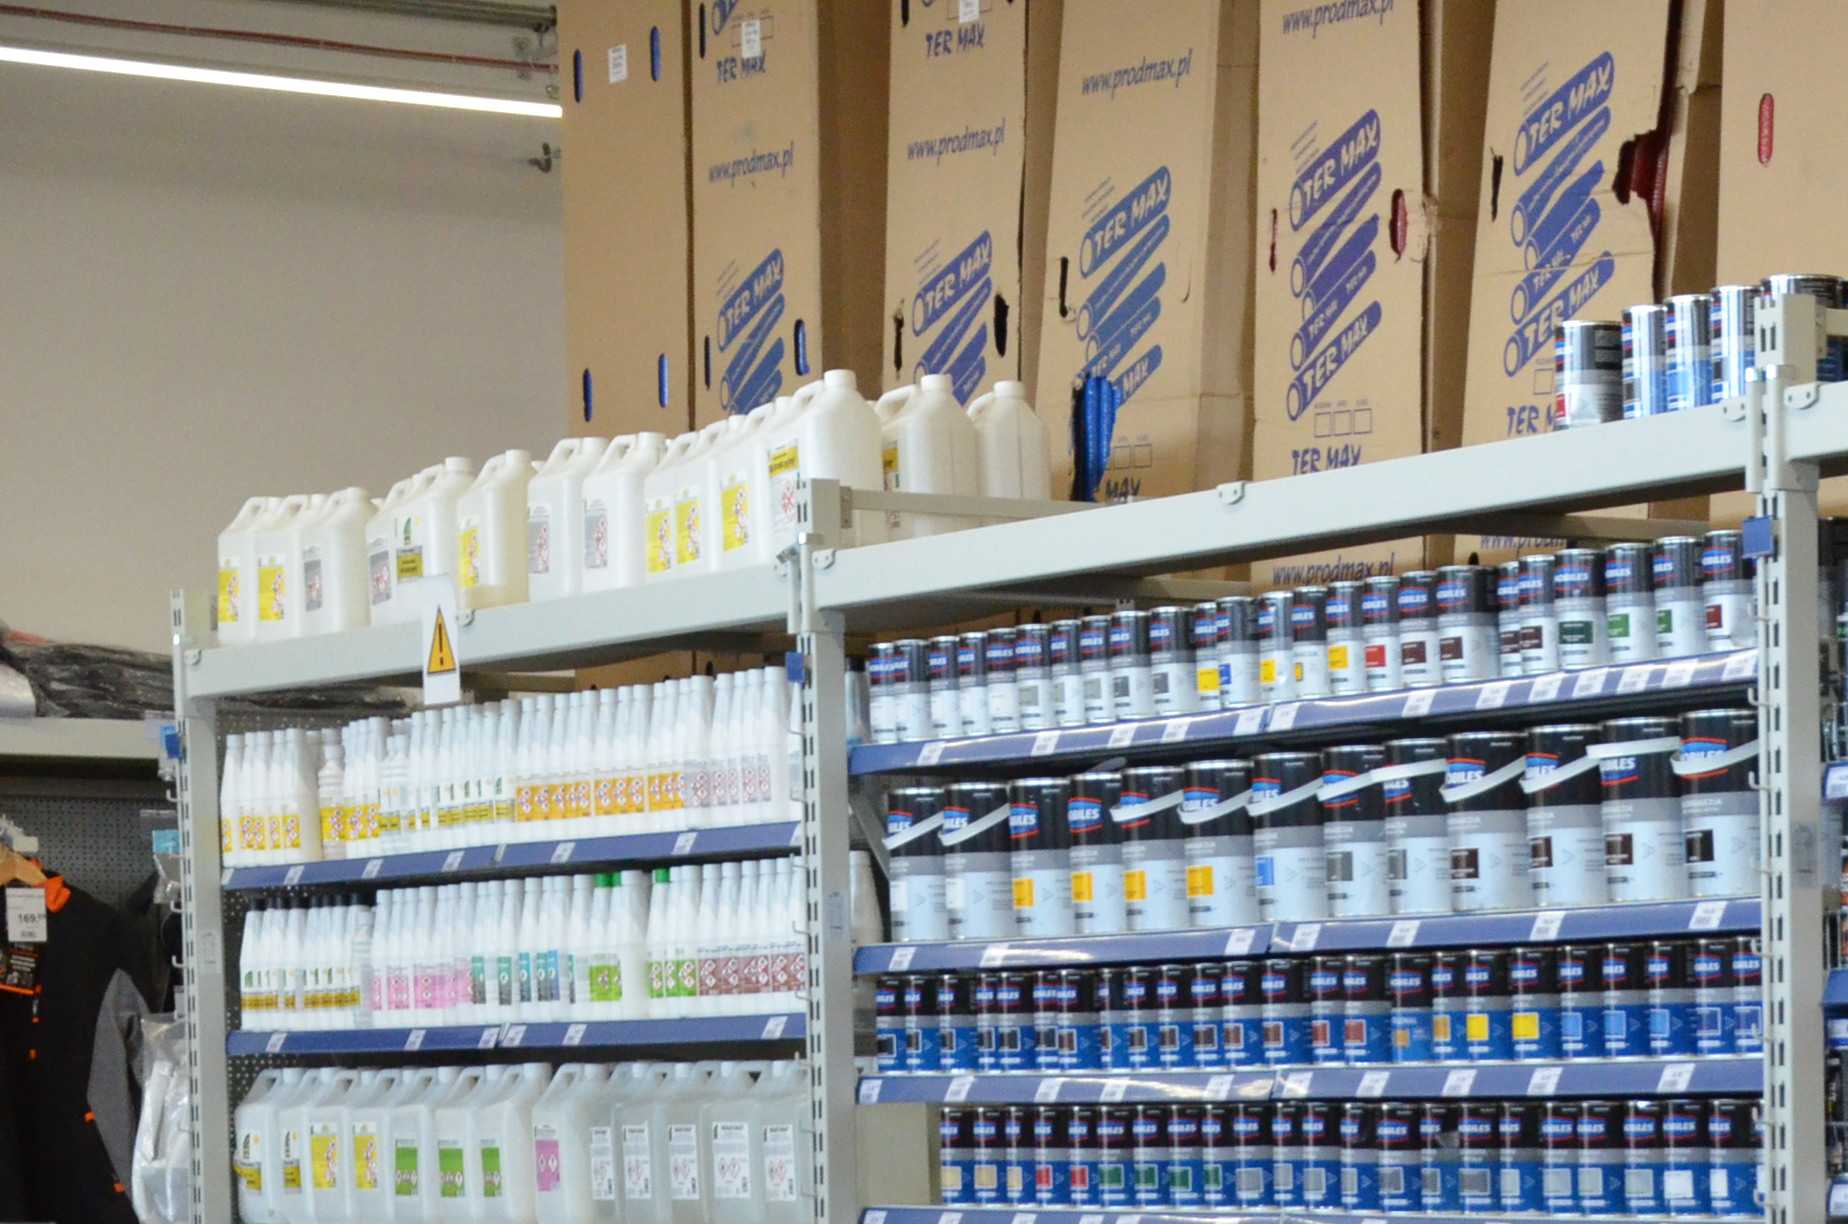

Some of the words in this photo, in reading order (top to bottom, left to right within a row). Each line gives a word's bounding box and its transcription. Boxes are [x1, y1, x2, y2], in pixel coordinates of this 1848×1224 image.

[1081, 48, 1194, 99] www.prodmax.pl
[1528, 114, 1562, 149] TER
[1567, 59, 1611, 120] MAX
[708, 140, 795, 189] www.prodmax.pl
[907, 117, 1007, 167] www.prodmax.pl
[1302, 163, 1336, 208] TER
[1339, 117, 1379, 178] MAX
[1093, 213, 1127, 257] TER
[1130, 173, 1169, 229] MAX
[925, 272, 957, 317] TER
[1522, 302, 1566, 350] TER
[1569, 267, 1600, 310] MAX
[1302, 351, 1337, 398] TER
[1340, 311, 1370, 357] MAX
[1506, 405, 1541, 434] TER
[1292, 447, 1322, 476] TER
